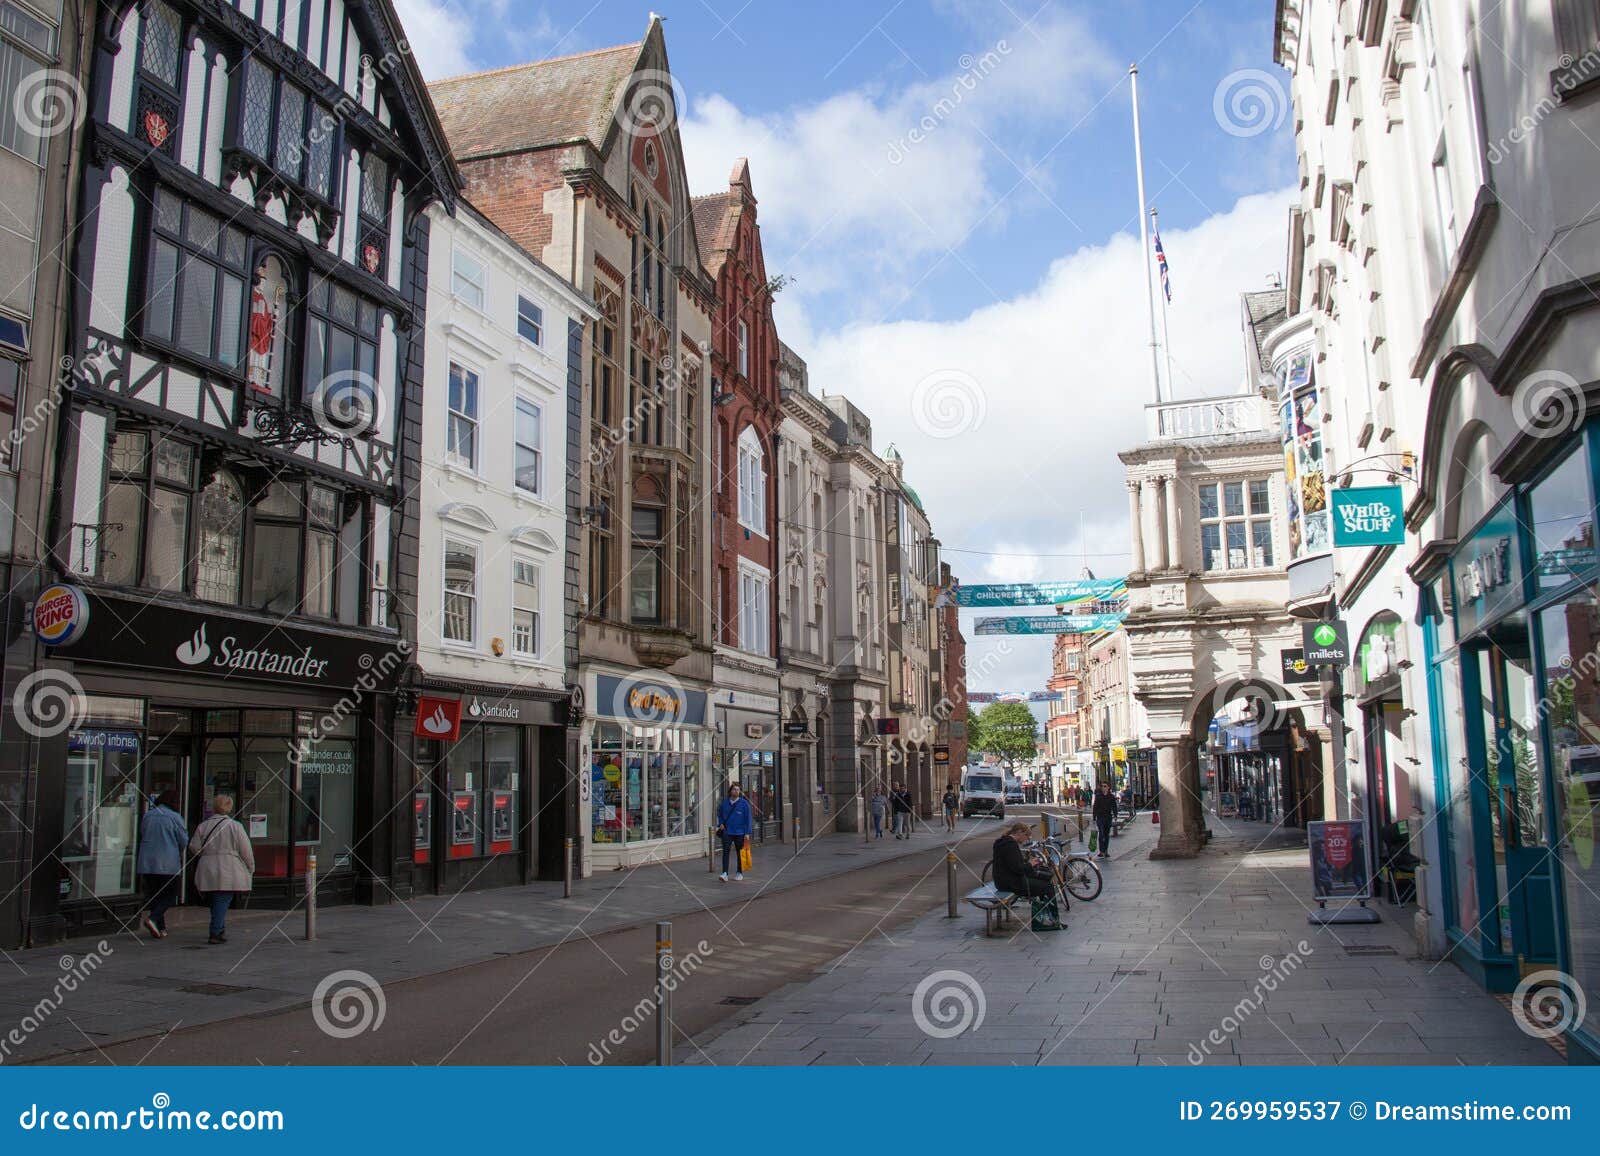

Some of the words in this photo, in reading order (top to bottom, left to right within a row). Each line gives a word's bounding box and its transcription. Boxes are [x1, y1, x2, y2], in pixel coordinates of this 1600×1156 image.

[1023, 589, 1046, 598] SOFT
[35, 593, 73, 616] BURGER
[36, 605, 74, 633] KING
[1030, 621, 1093, 630] MEMBERSHIPS
[214, 635, 329, 679] Santander
[1308, 649, 1345, 660] millets
[481, 701, 520, 720] Santander
